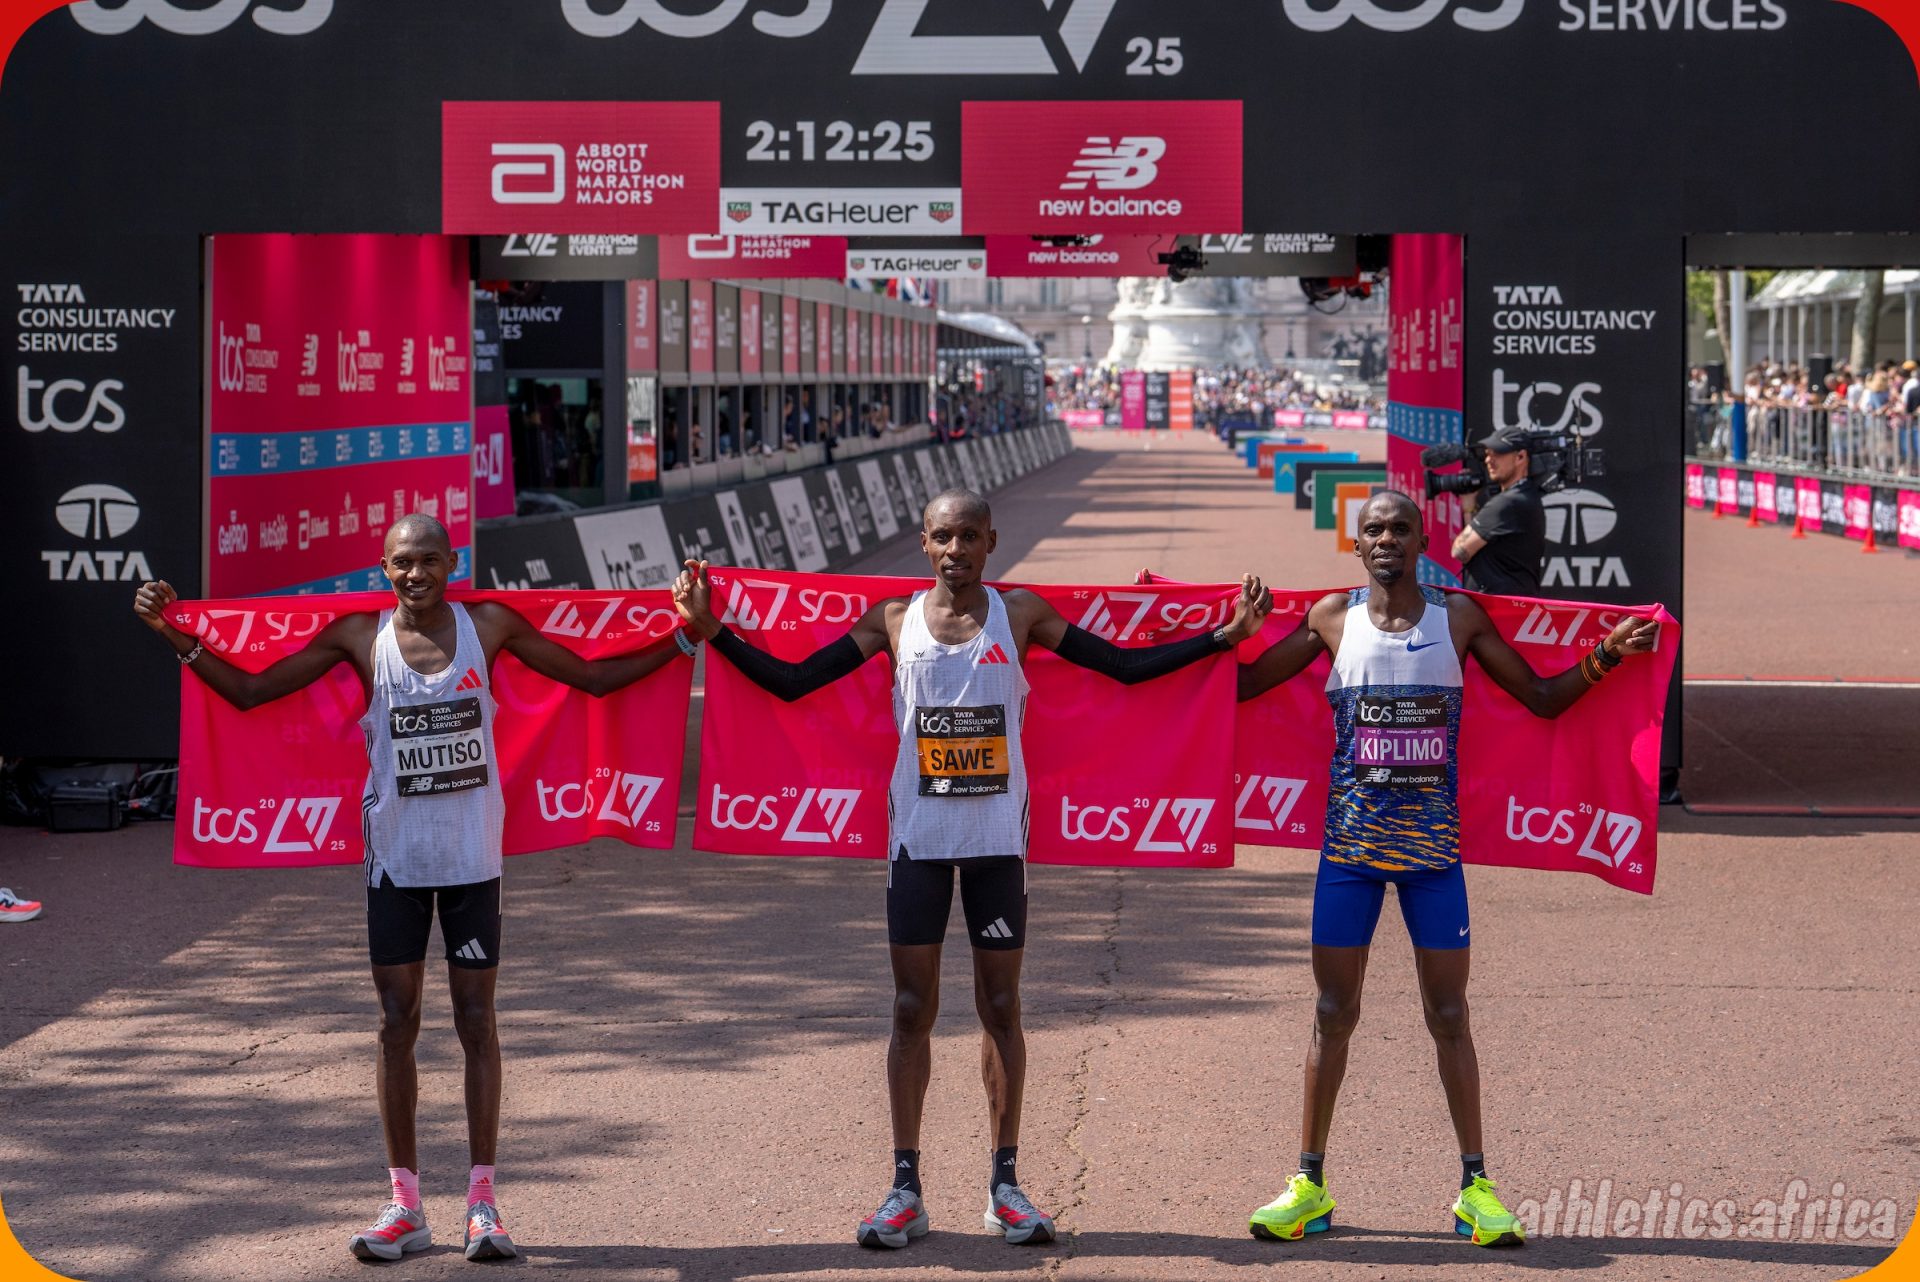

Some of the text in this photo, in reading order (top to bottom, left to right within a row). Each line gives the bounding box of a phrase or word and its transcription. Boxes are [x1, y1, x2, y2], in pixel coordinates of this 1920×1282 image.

[1558, 0, 1787, 31] SERVICES
[1125, 37, 1184, 76] 25
[576, 144, 648, 157] ABBOTT
[745, 120, 935, 162] 2:12:25
[576, 159, 642, 172] WORLD
[576, 175, 685, 189] MARATHON
[576, 190, 653, 205] MAJORS
[1038, 196, 1182, 217] new balance
[569, 234, 638, 246] MARATHON
[742, 239, 811, 248] MARATHON
[1264, 242, 1310, 253] EVENTS
[569, 246, 613, 256] EVENTS
[742, 249, 792, 259] MAJORS
[1028, 250, 1120, 263] new balance
[17, 284, 86, 304] TATA
[1493, 286, 1564, 305] TATA
[17, 308, 175, 329] CONSULTANCY
[499, 306, 563, 322] LTANCY
[1493, 310, 1657, 330] CONSULTANCY
[17, 333, 118, 352] SERVICES
[1493, 335, 1597, 354] SERVICES
[219, 320, 244, 392] tcs
[337, 331, 358, 392] tcs
[17, 365, 126, 433] tcs
[1492, 368, 1604, 437] tcs
[41, 551, 156, 582] TATA
[1540, 556, 1632, 587] ATA
[430, 706, 452, 715] TATA
[431, 710, 476, 723] CONSULTANCY
[1360, 701, 1392, 722] tcs
[1395, 707, 1441, 715] CONSULTANCY
[395, 712, 429, 733] tcs
[431, 720, 462, 730] SERVICES
[920, 712, 951, 733] tcs
[954, 718, 999, 726] CONSULTANCY
[954, 725, 985, 733] SERVICES
[397, 738, 482, 771] MUTISO
[1360, 737, 1443, 761] KIPLIMO
[931, 748, 995, 771] SAWE
[434, 777, 481, 790] new balance
[969, 783, 1000, 793] balance
[1409, 775, 1439, 783] balance
[595, 767, 611, 779] 20
[645, 821, 661, 832] 25
[711, 783, 778, 831] tcs
[781, 786, 798, 798] 20
[847, 833, 863, 844] 25
[192, 796, 258, 844] tcs
[259, 798, 276, 809] 20
[330, 840, 346, 851] 25
[1061, 796, 1131, 841] tcs
[1133, 797, 1150, 809] 20
[1201, 843, 1217, 854] 25
[1290, 822, 1306, 833] 25
[1505, 795, 1575, 844] tcs
[1578, 803, 1593, 814] 20
[1628, 863, 1643, 874] 25
